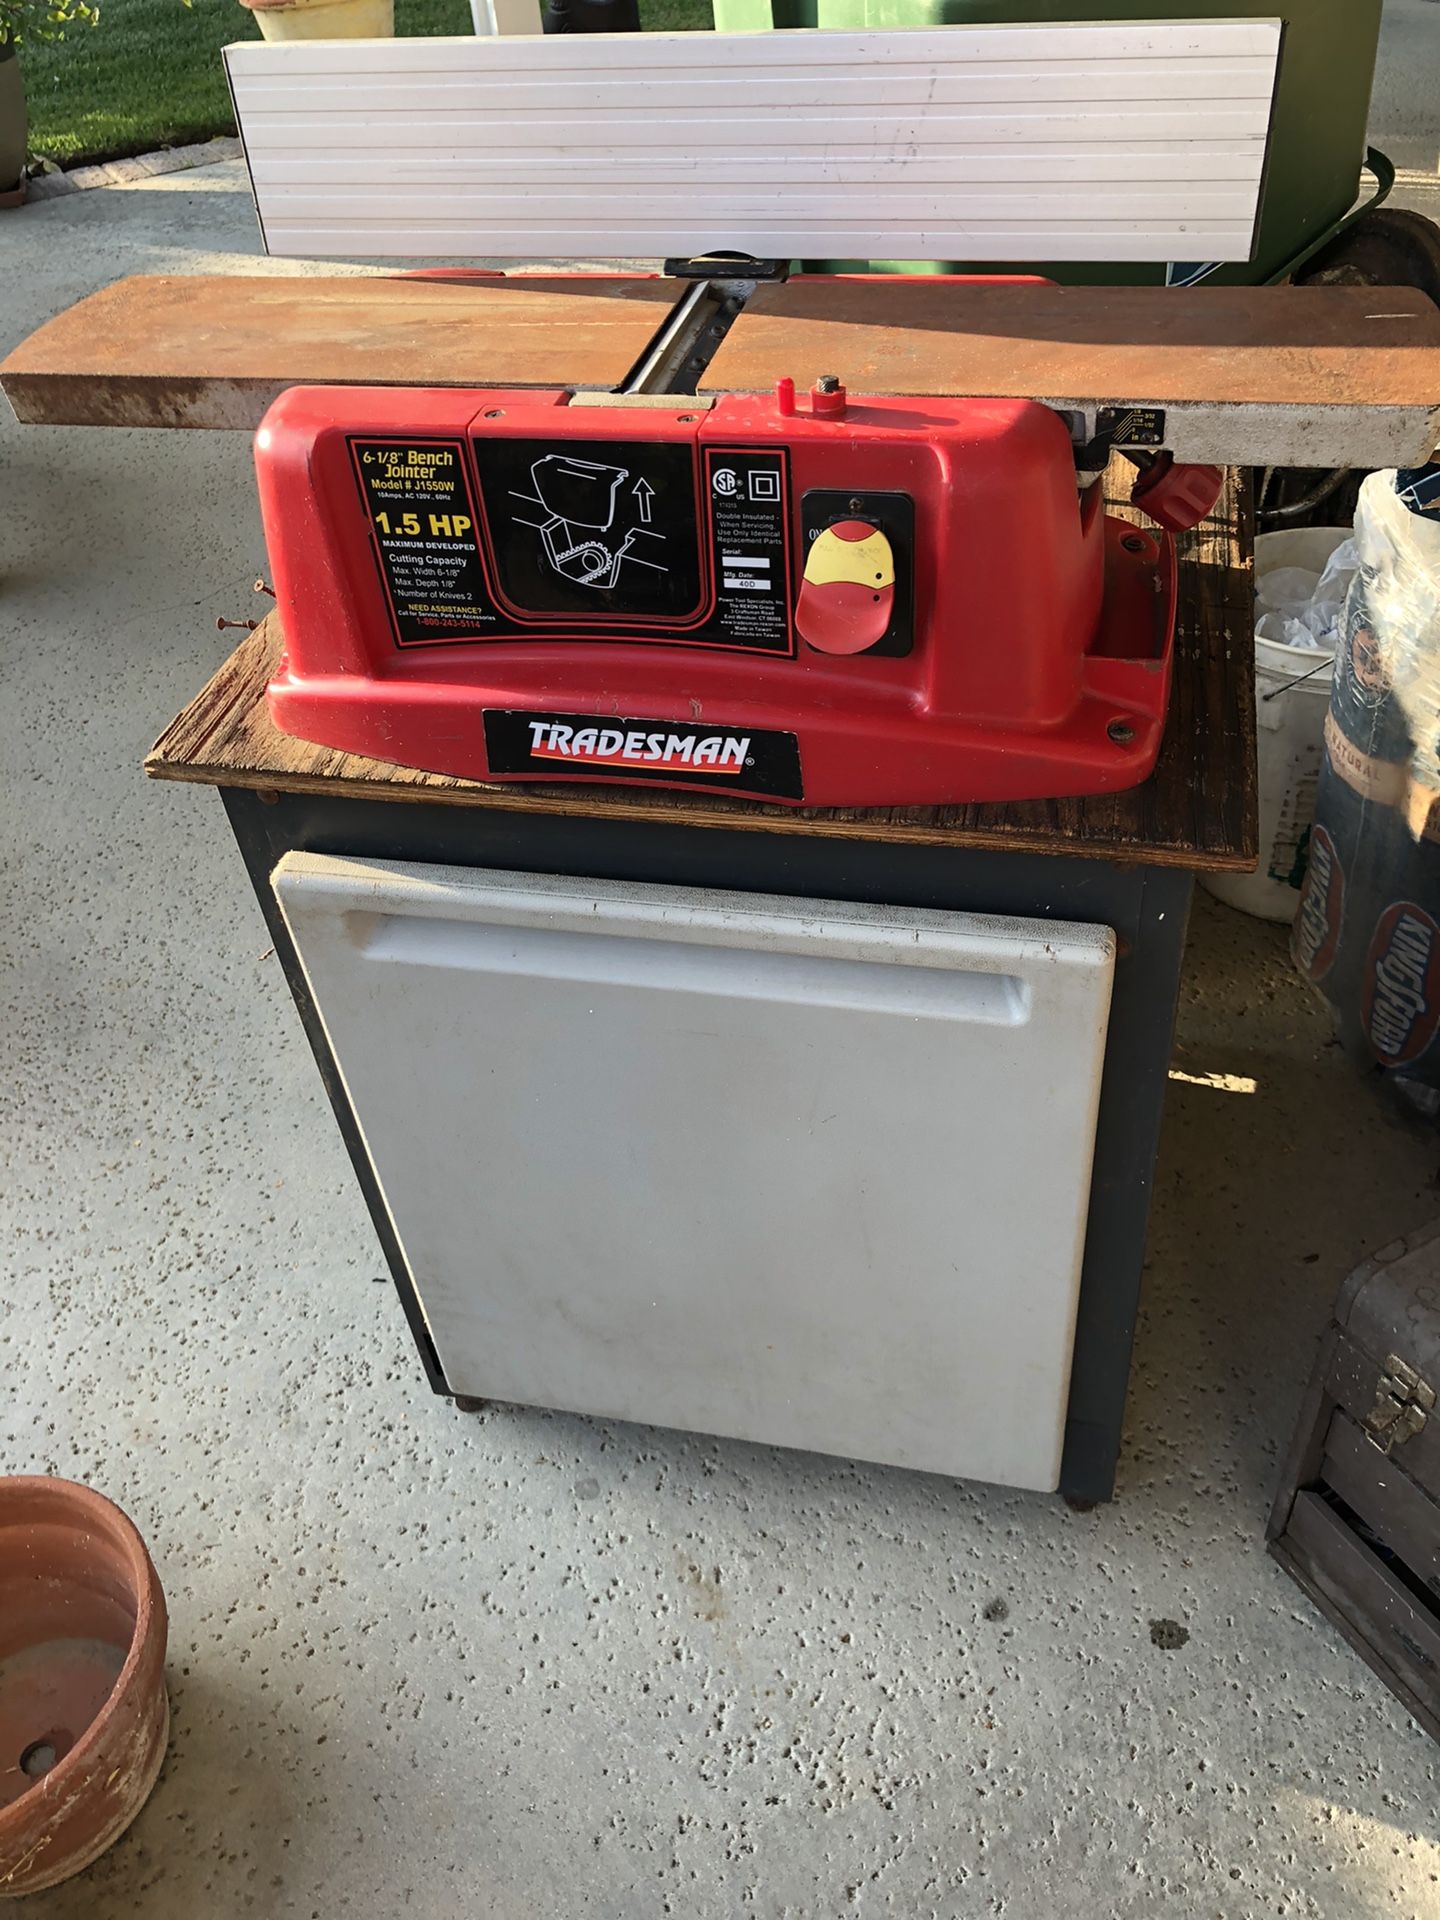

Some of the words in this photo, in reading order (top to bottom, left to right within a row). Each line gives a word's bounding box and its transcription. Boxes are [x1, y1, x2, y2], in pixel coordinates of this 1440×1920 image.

[363, 451, 403, 464] 6-1/8"
[408, 450, 453, 466] Bench
[384, 464, 436, 478] Jointer
[371, 478, 403, 490] Model
[405, 480, 412, 490] #
[414, 480, 454, 492] J1550W
[376, 512, 420, 535] 1.5
[428, 514, 471, 537] HP
[382, 540, 424, 548] MAXIMUM
[426, 542, 476, 551] DEVELOPED
[388, 554, 424, 566] Cutting
[426, 556, 467, 568] Capacity
[392, 566, 412, 575] Max.
[412, 567, 436, 576] Width
[437, 569, 460, 577] 6-1/8"
[395, 578, 414, 586] Max.
[416, 578, 439, 588] Depth
[441, 580, 456, 588] 1/8"
[397, 589, 428, 598] Number
[440, 592, 466, 600] Knives
[408, 604, 430, 612] NEED
[430, 604, 482, 614] ASSISTANCE?
[528, 721, 751, 766] TRADESMAN
[1331, 733, 1381, 782] NATURAL
[1370, 913, 1433, 1056] KINGSFORD
